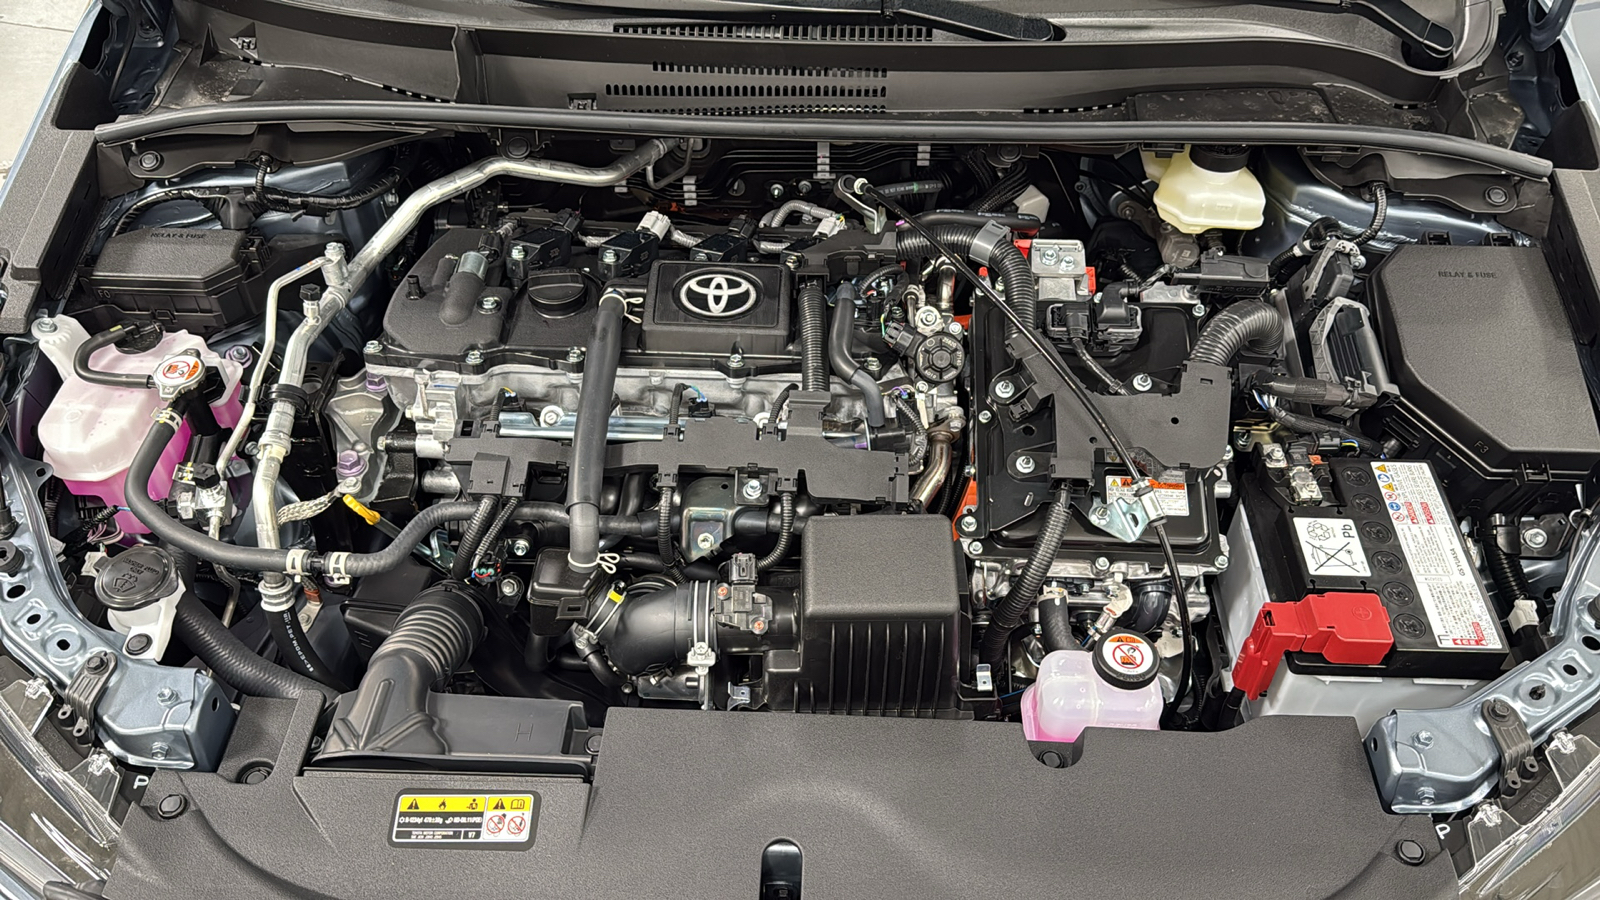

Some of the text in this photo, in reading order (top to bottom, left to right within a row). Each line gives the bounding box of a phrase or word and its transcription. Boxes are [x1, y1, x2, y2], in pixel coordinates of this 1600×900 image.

[1475, 271, 1498, 279] FUSE
[1340, 524, 1356, 538] Pb
[1448, 547, 1462, 567] YUASA
[133, 775, 150, 790] P
[1435, 824, 1450, 840] P
